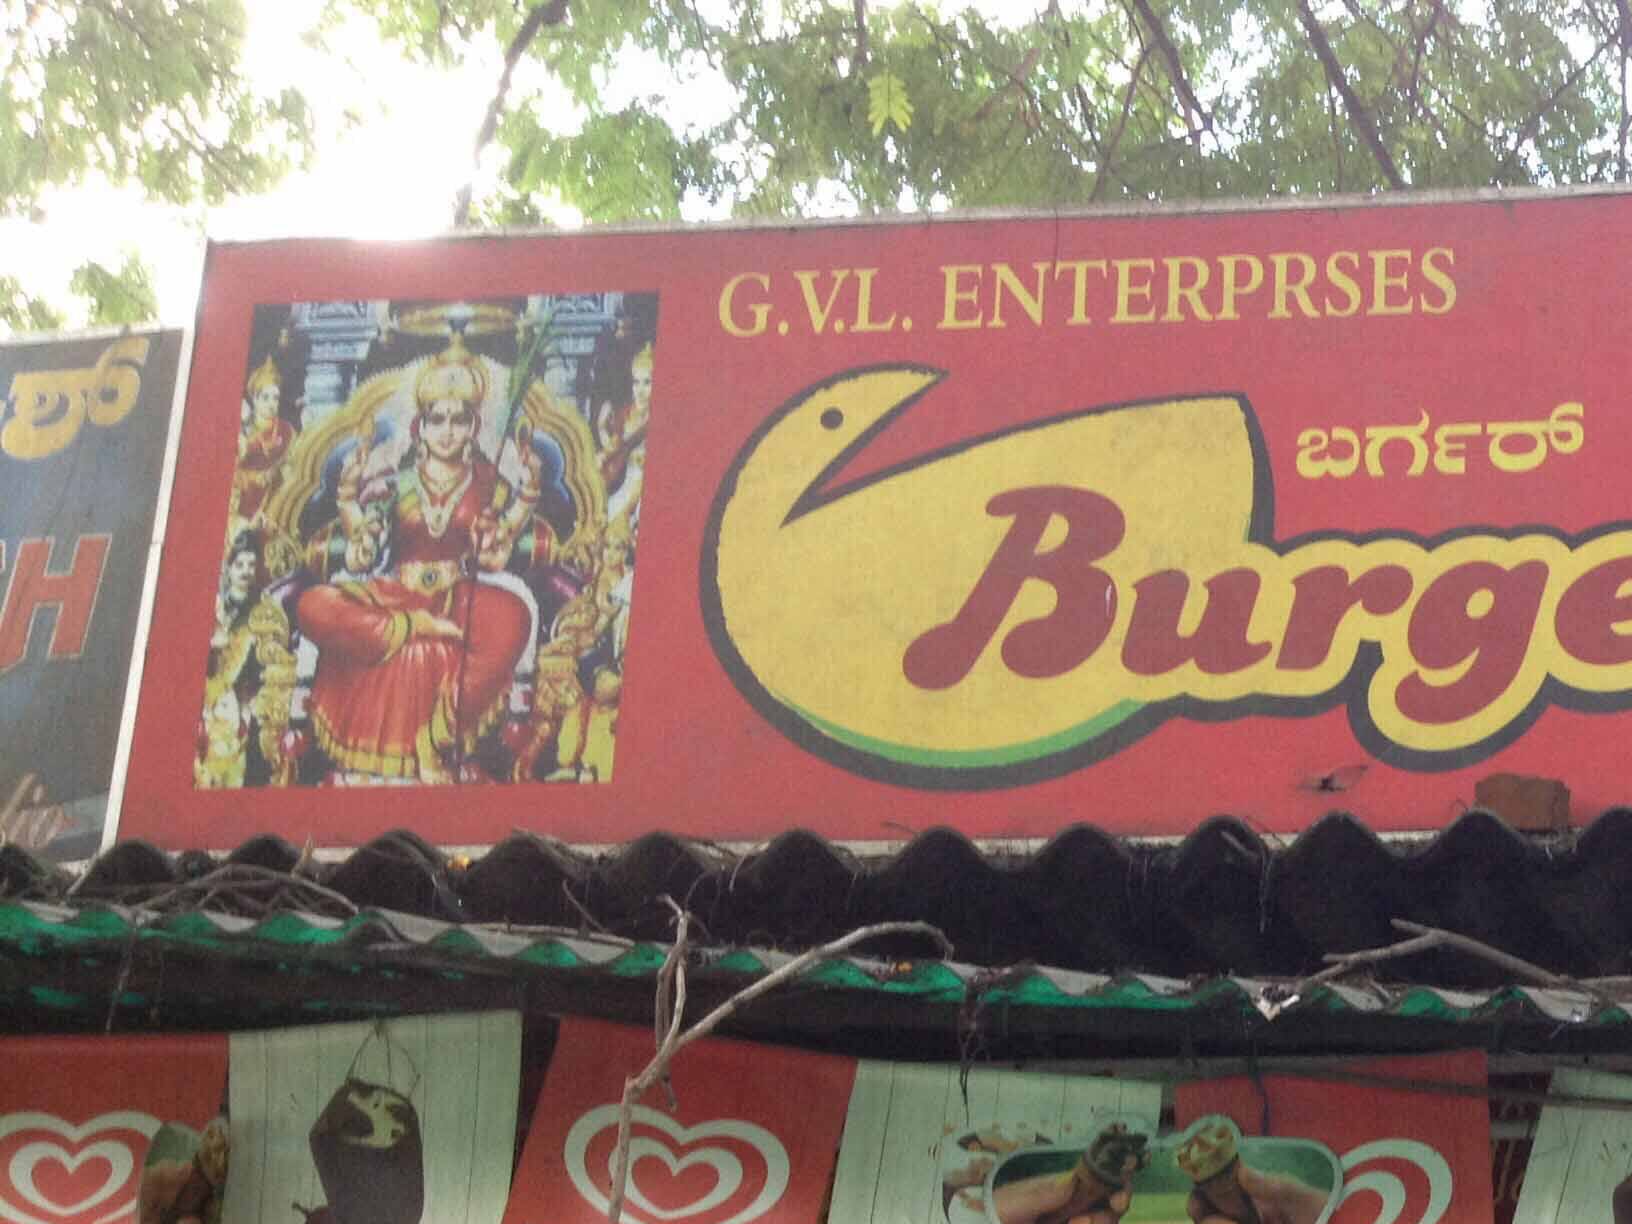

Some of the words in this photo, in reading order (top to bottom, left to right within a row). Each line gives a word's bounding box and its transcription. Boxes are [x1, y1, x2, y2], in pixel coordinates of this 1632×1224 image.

[718, 266, 912, 337] G.V.L.
[936, 246, 1459, 332] ENTERPRSES
[0, 533, 112, 672] H
